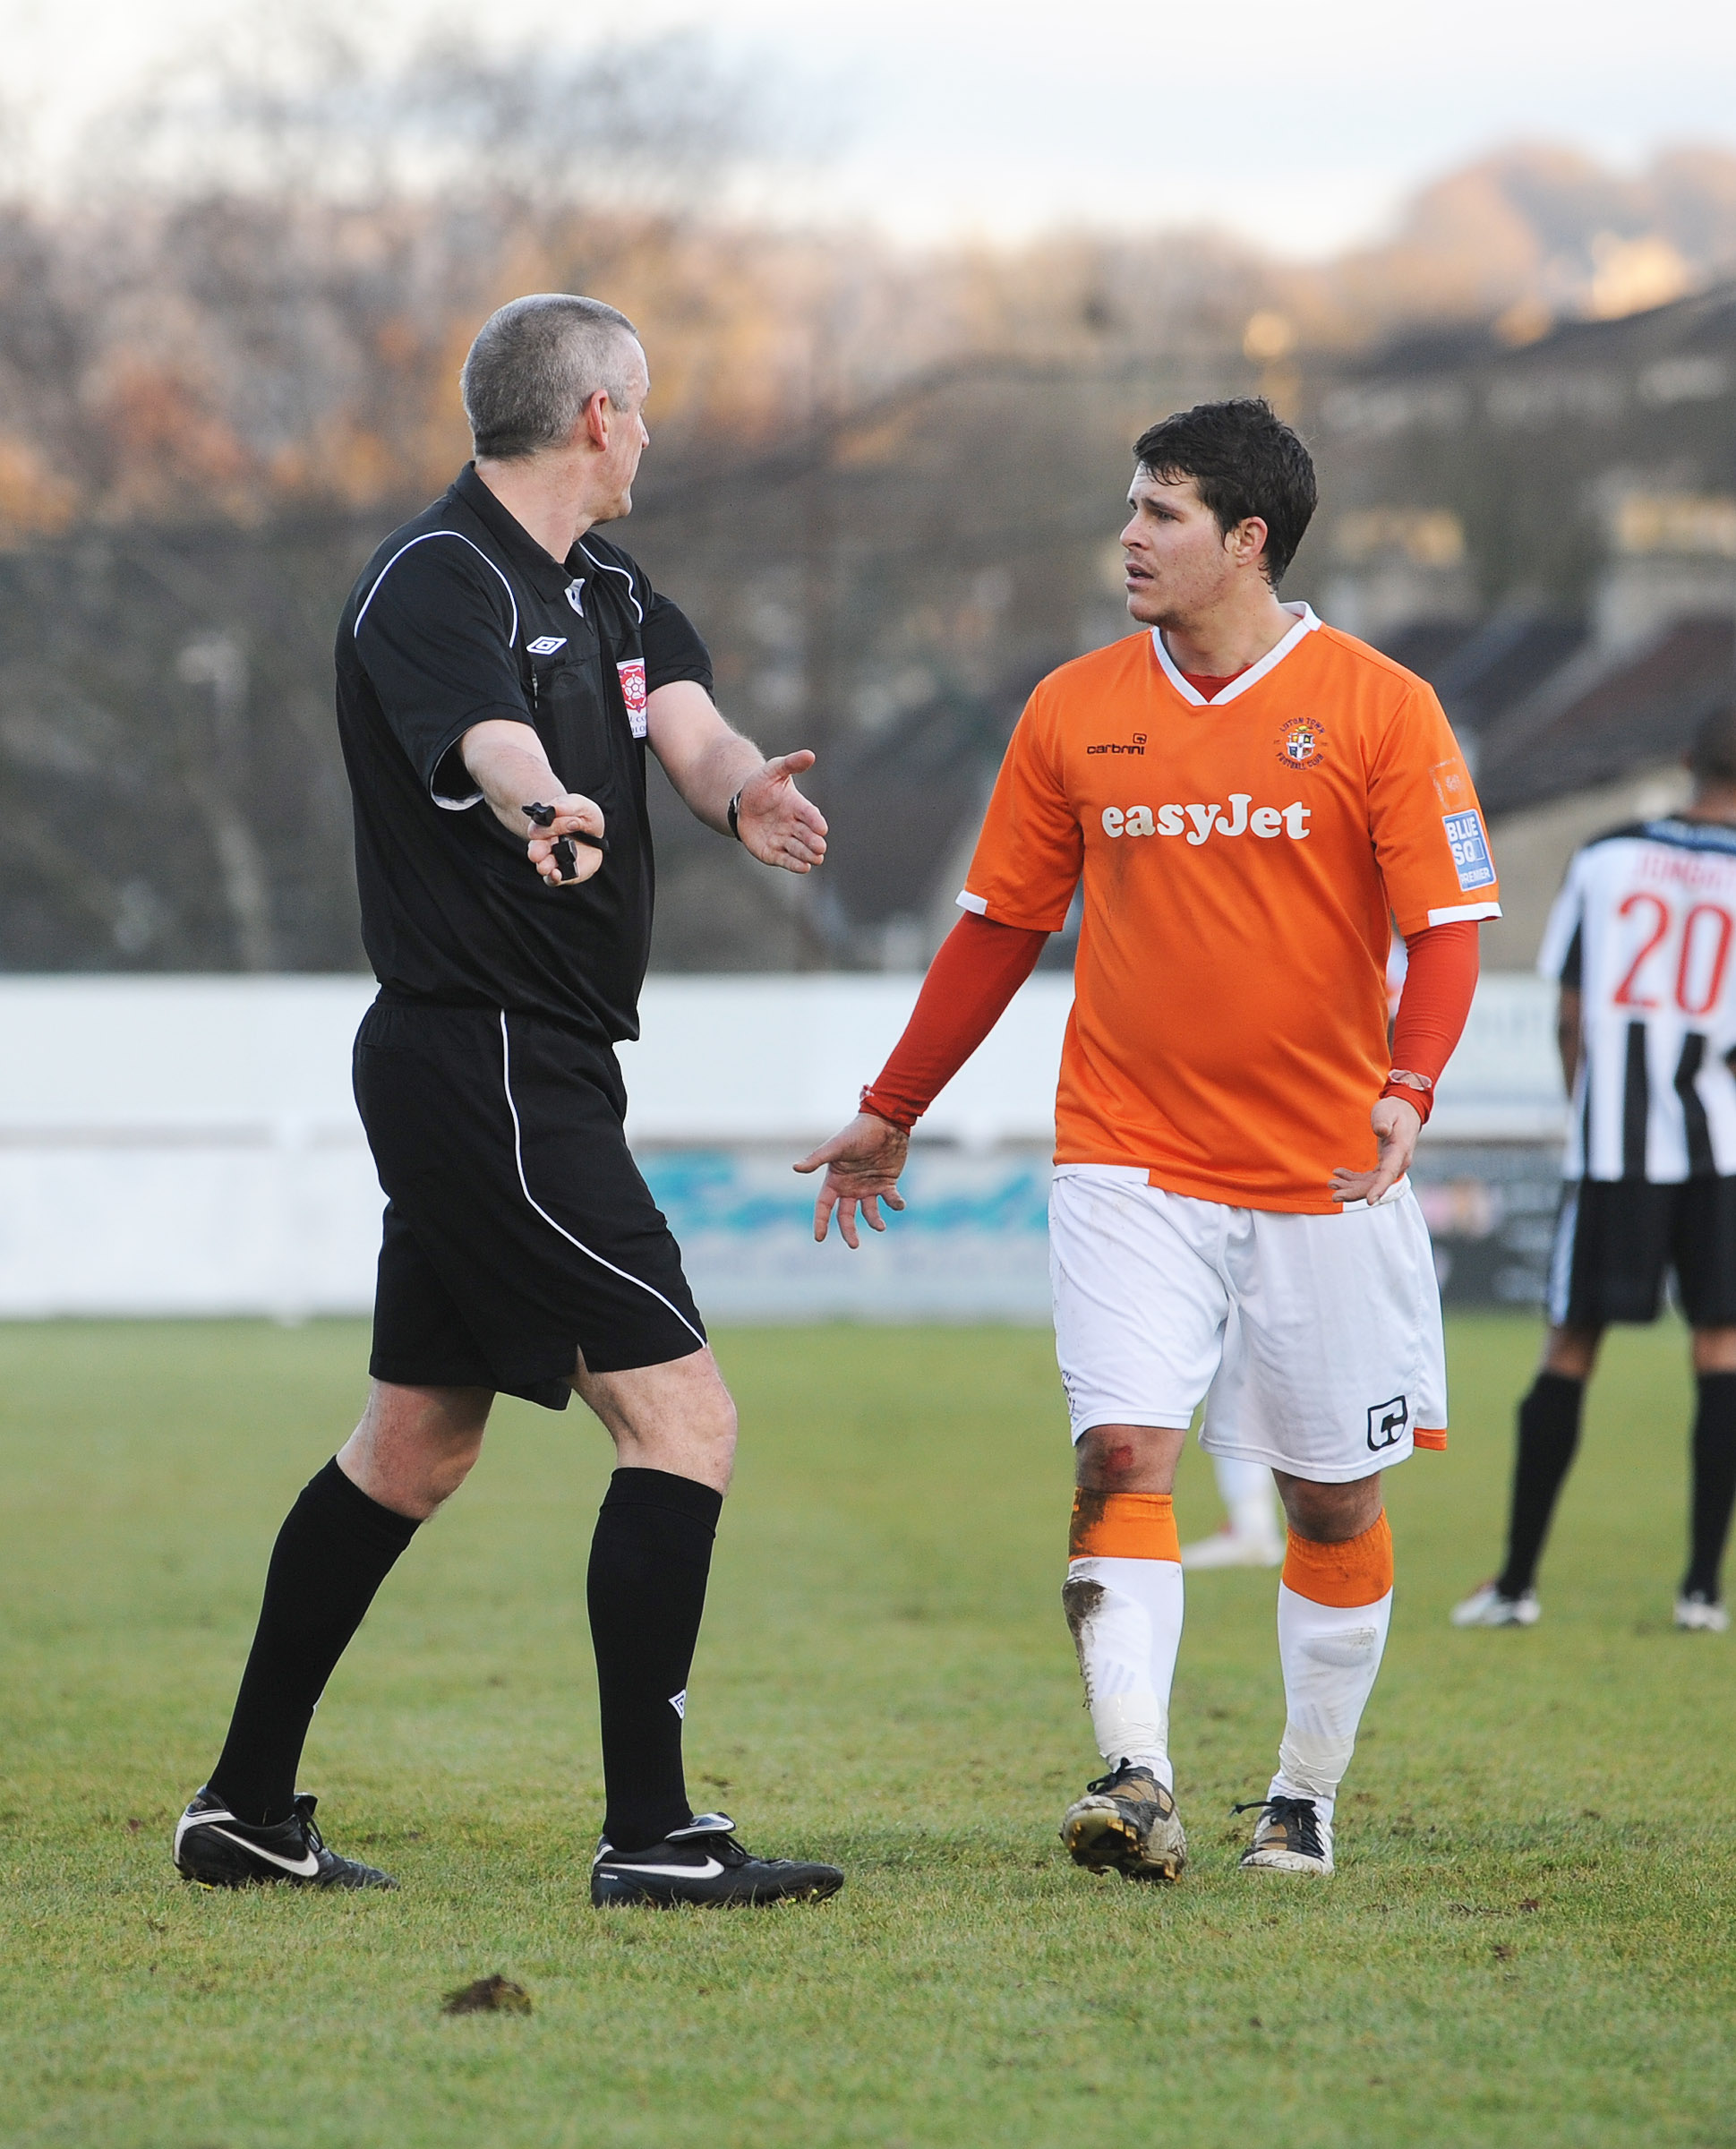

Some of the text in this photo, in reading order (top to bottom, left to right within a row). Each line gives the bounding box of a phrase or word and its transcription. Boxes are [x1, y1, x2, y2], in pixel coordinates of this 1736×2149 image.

[1278, 717, 1325, 734] LUTON TOWN
[1086, 743, 1145, 755] carbrini
[1276, 752, 1324, 770] FOOTBALL CLUB
[1101, 793, 1312, 846] easyJet
[1445, 816, 1479, 843] BLUE
[1451, 840, 1477, 866] SQ
[1459, 867, 1491, 884] PREMIER
[1612, 891, 1734, 1017] 20
